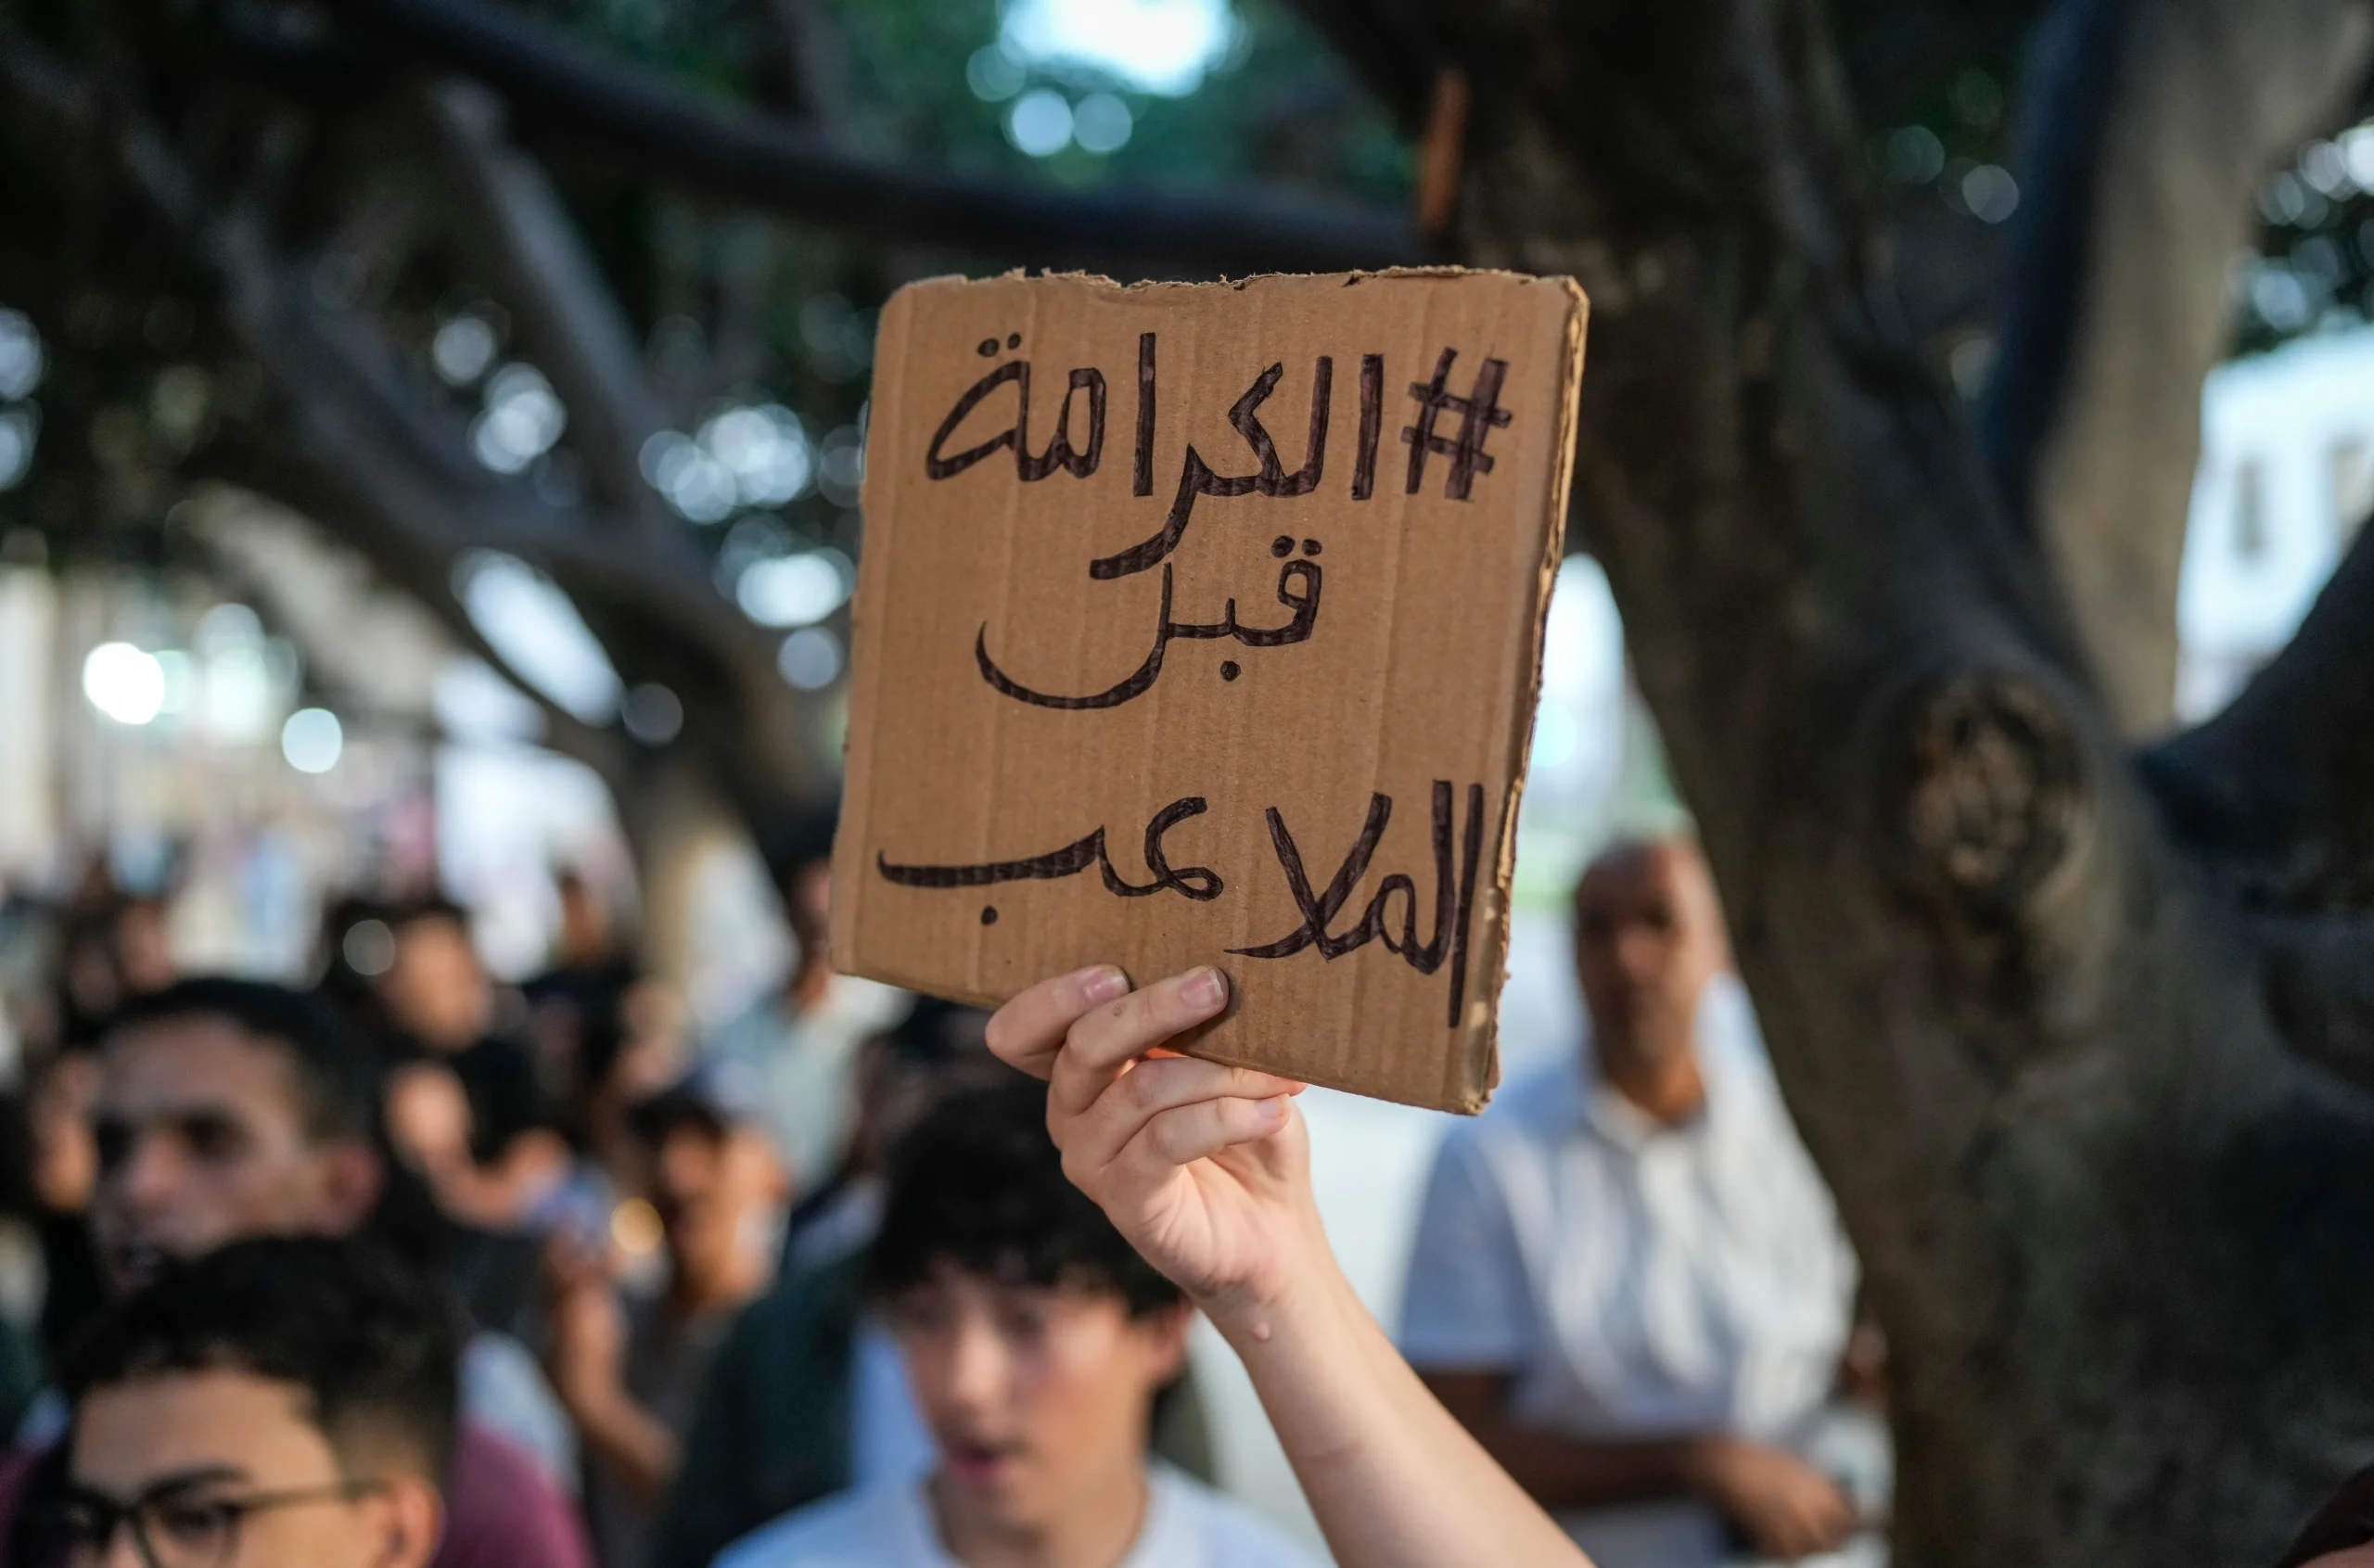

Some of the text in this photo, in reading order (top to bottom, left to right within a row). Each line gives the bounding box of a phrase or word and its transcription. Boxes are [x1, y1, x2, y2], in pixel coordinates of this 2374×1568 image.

[925, 331, 1513, 580] #الكرامة
[975, 534, 1322, 711] قبل
[876, 779, 1485, 1029] الملاعب
